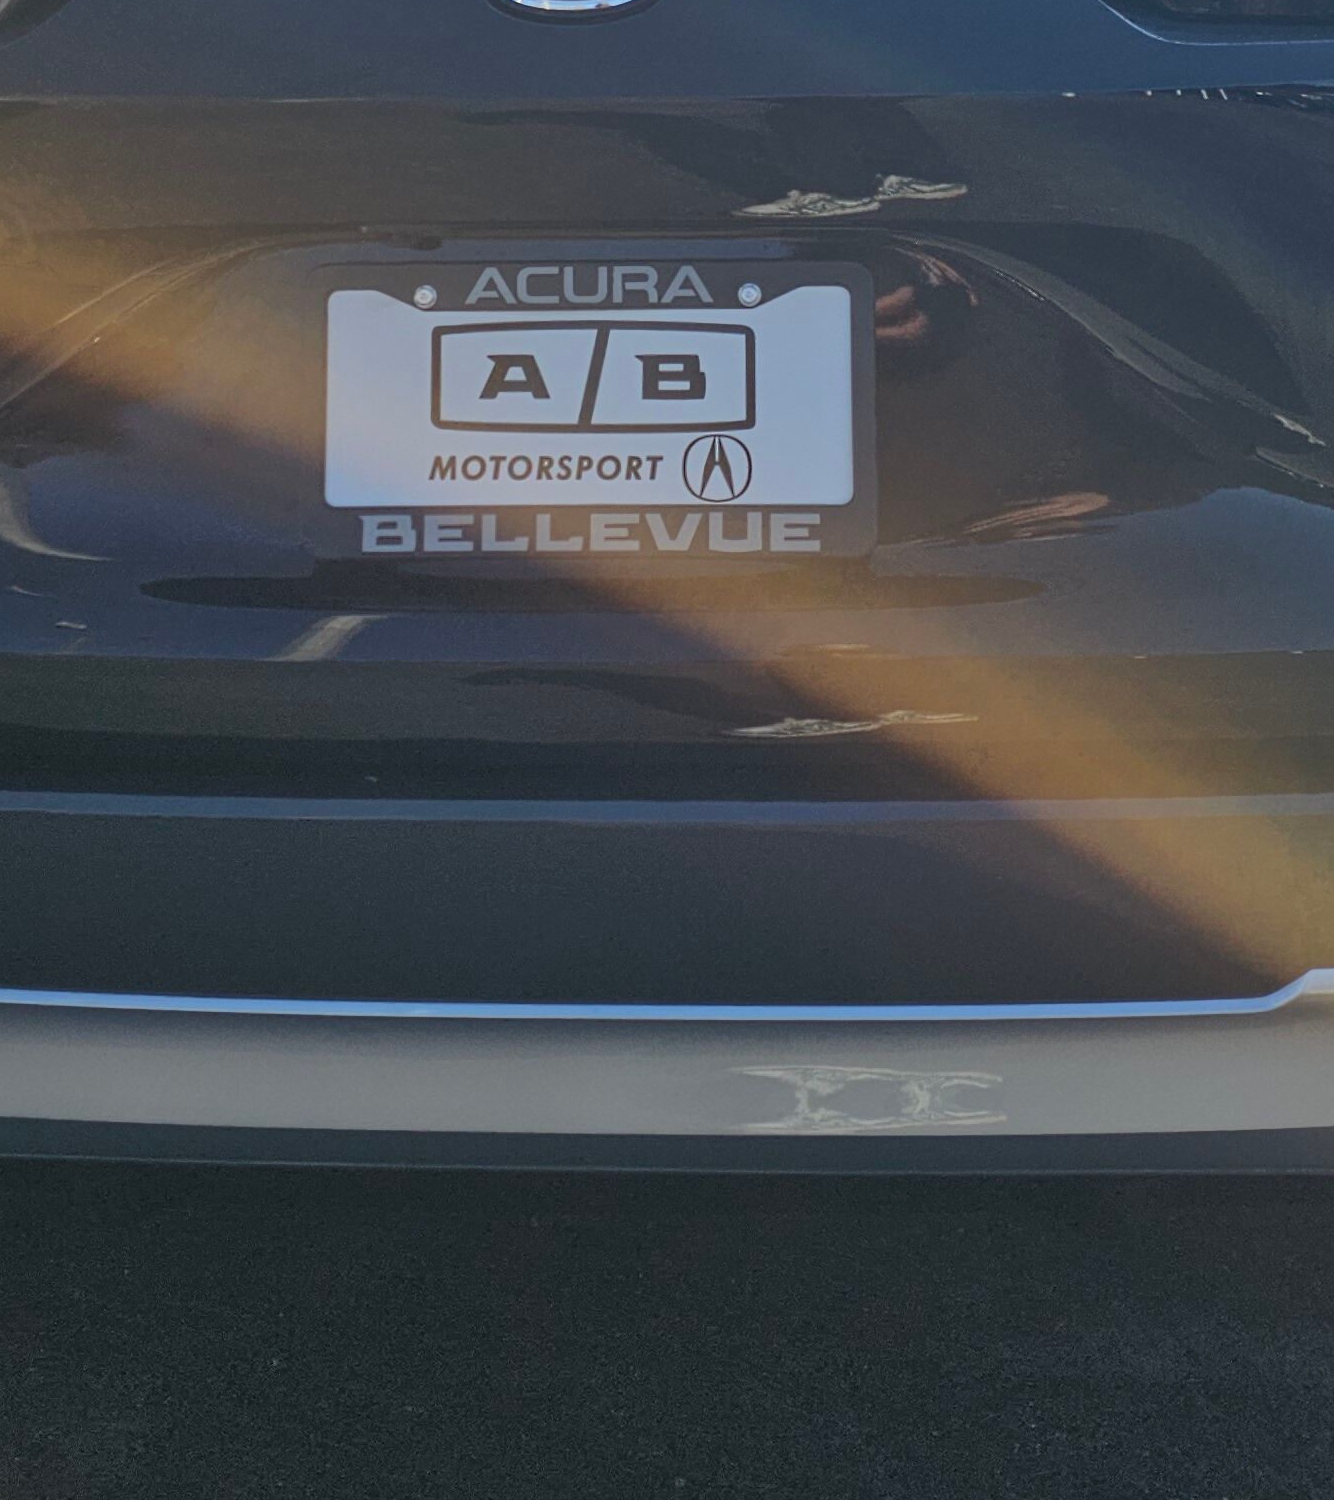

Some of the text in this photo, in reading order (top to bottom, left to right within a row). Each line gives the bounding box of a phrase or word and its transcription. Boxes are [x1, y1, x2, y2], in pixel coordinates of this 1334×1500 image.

[466, 265, 713, 304] ACURA
[428, 454, 663, 481] MOTORSPORT
[359, 512, 821, 553] BELLEVUE
